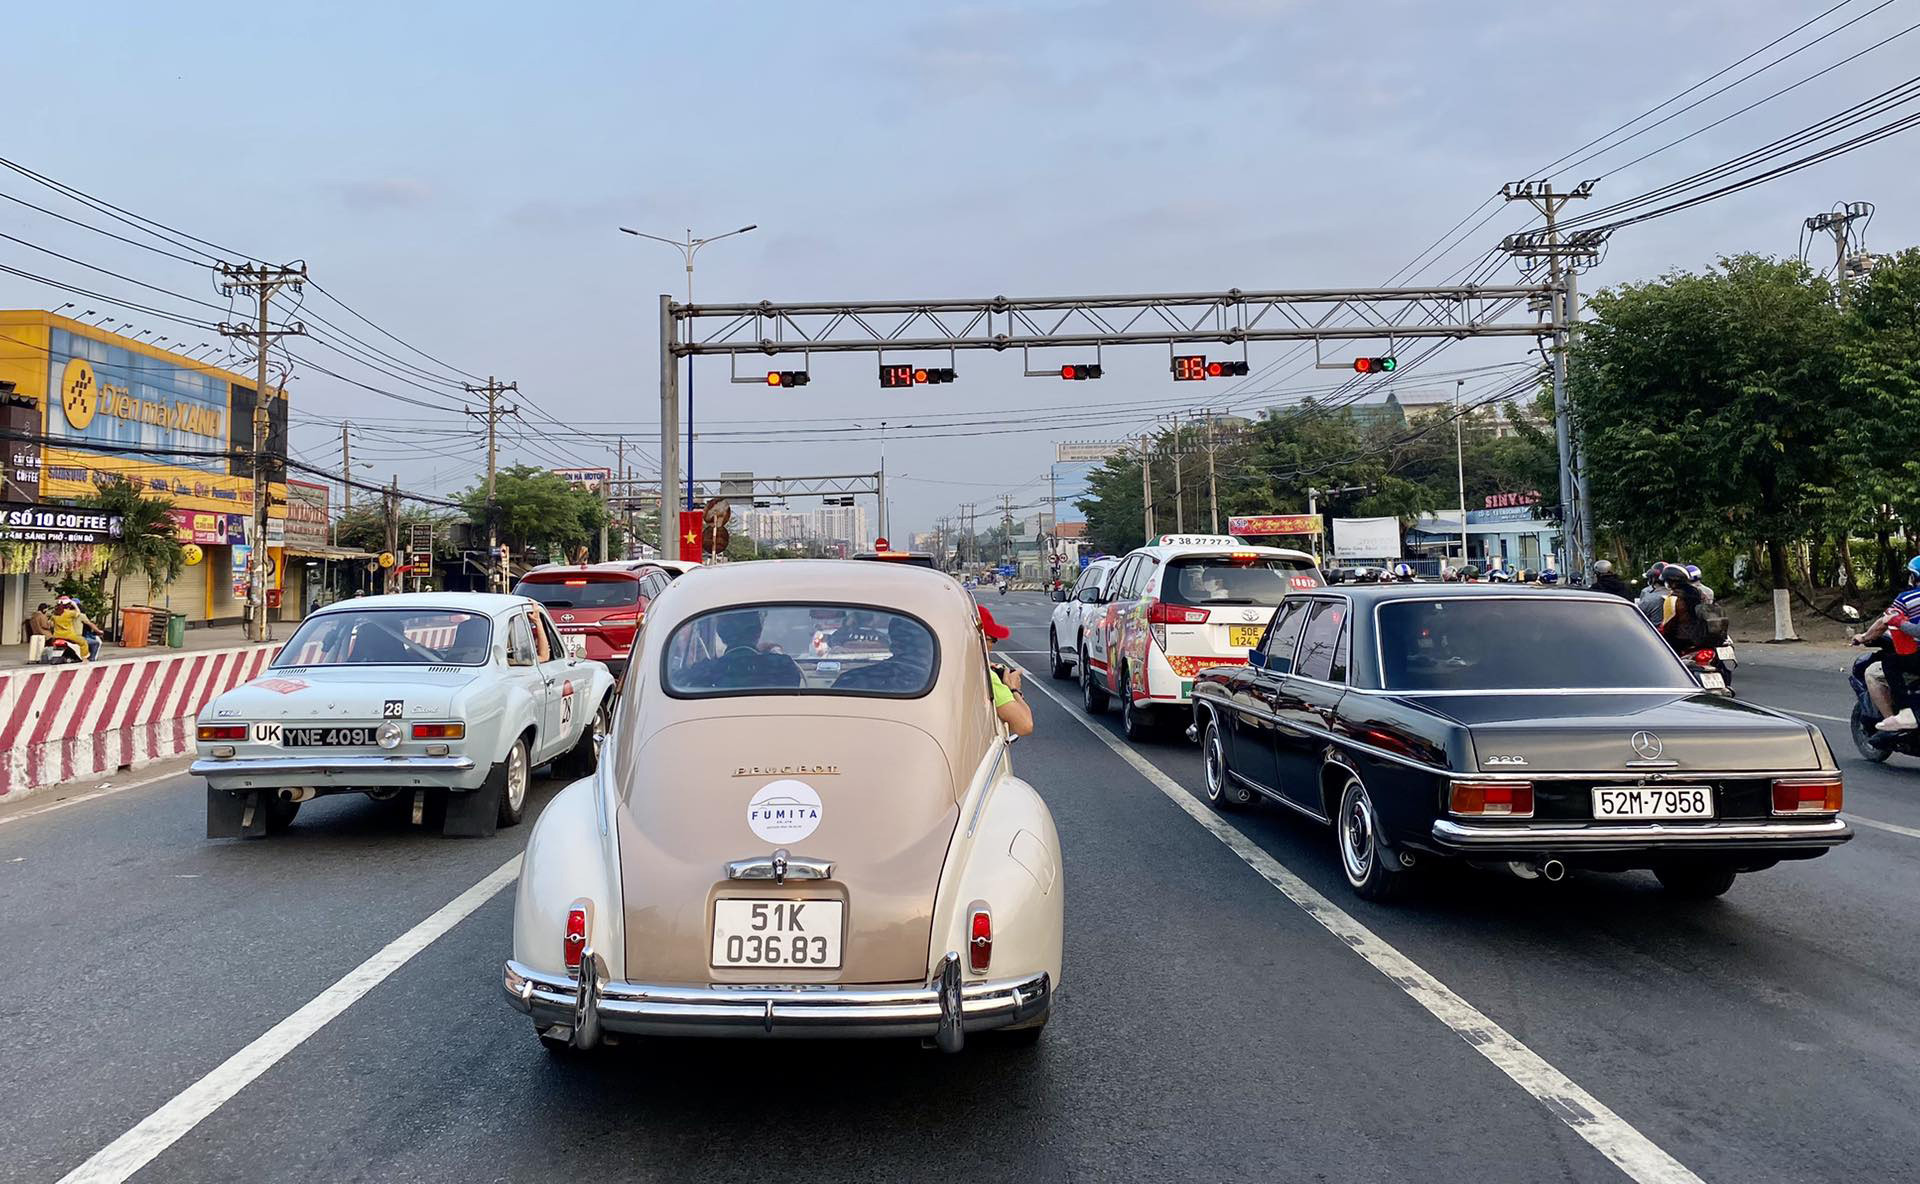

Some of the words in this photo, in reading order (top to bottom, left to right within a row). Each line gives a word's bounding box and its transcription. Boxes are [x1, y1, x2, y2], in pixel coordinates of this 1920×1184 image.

[891, 368, 910, 385] 14
[175, 400, 222, 439] XANH
[9, 508, 33, 525] SỐ
[35, 513, 54, 526] 10
[56, 514, 107, 529] COFFEE
[1235, 636, 1260, 646] 124.7
[384, 702, 403, 716] 28
[562, 696, 572, 723] 28
[256, 725, 281, 741] UK
[285, 730, 323, 746] YNE
[326, 729, 377, 745] 409L
[1600, 791, 1706, 815] 52M-7958
[751, 809, 818, 820] FUMITA
[751, 904, 805, 931] 51K
[726, 935, 828, 964] 036.83
